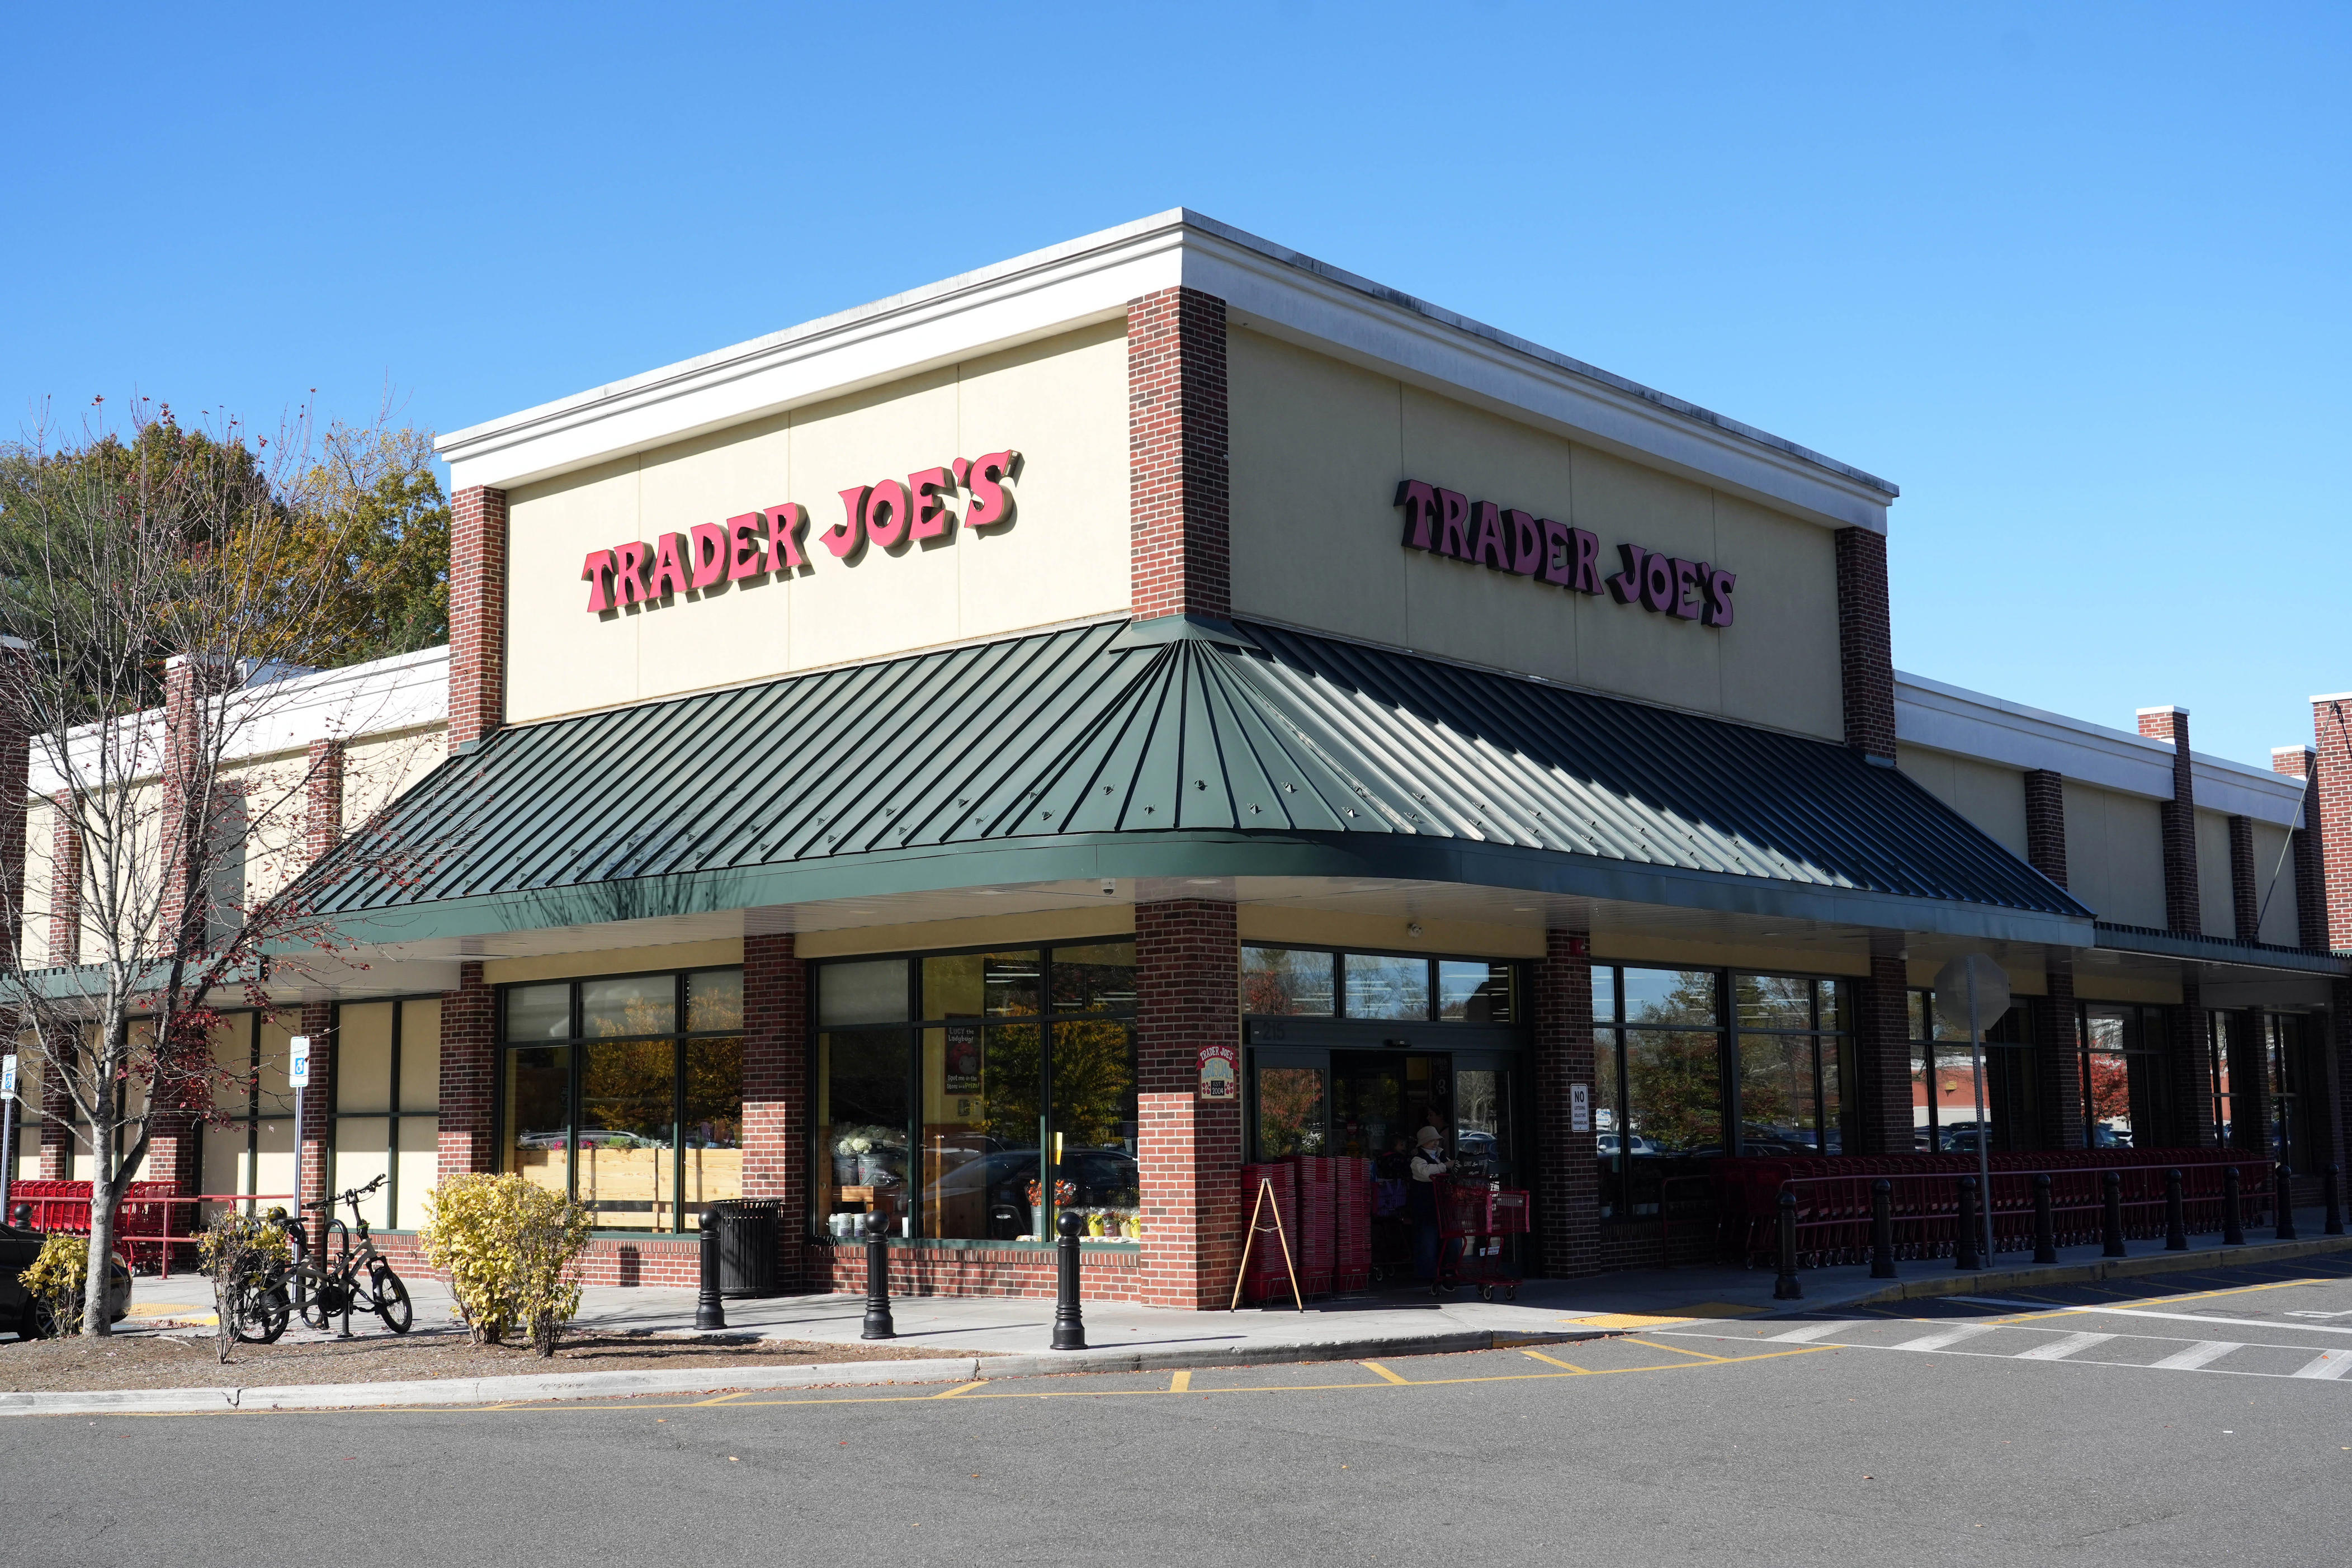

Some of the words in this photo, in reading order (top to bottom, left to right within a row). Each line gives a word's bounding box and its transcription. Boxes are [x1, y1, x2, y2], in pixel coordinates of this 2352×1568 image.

[582, 502, 809, 613] TRADER
[819, 449, 1022, 558] JOE'S
[1394, 479, 1604, 596] TRADER
[1605, 544, 1736, 627] JOE'S
[948, 1035, 974, 1043] Ladybug!
[1262, 1022, 1284, 1041] 215
[1199, 1046, 1219, 1061] TRADER
[1220, 1047, 1234, 1060] JOE'S
[1575, 1091, 1584, 1102] NO
